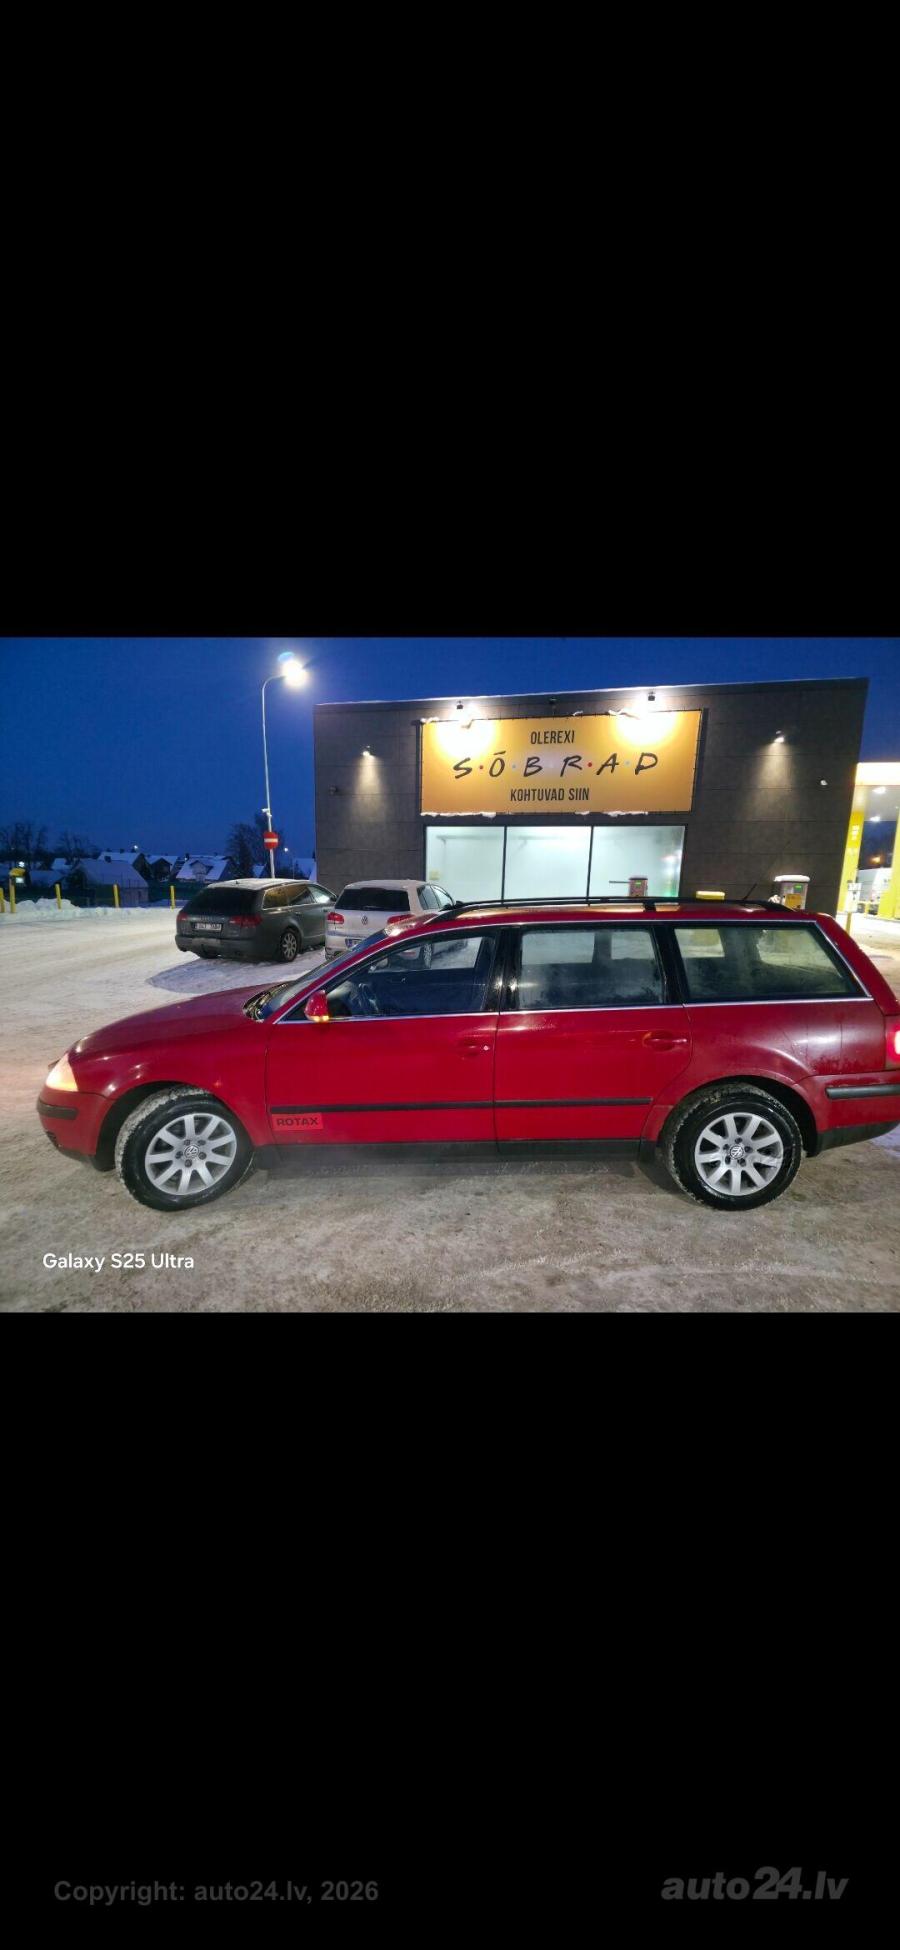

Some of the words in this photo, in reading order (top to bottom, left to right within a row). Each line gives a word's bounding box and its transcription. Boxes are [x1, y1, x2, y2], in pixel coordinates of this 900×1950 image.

[530, 730, 575, 745] OLEREXI
[510, 788, 565, 802] KOHTUVAD
[568, 787, 589, 801] SIIN
[276, 1116, 319, 1126] ROTAX
